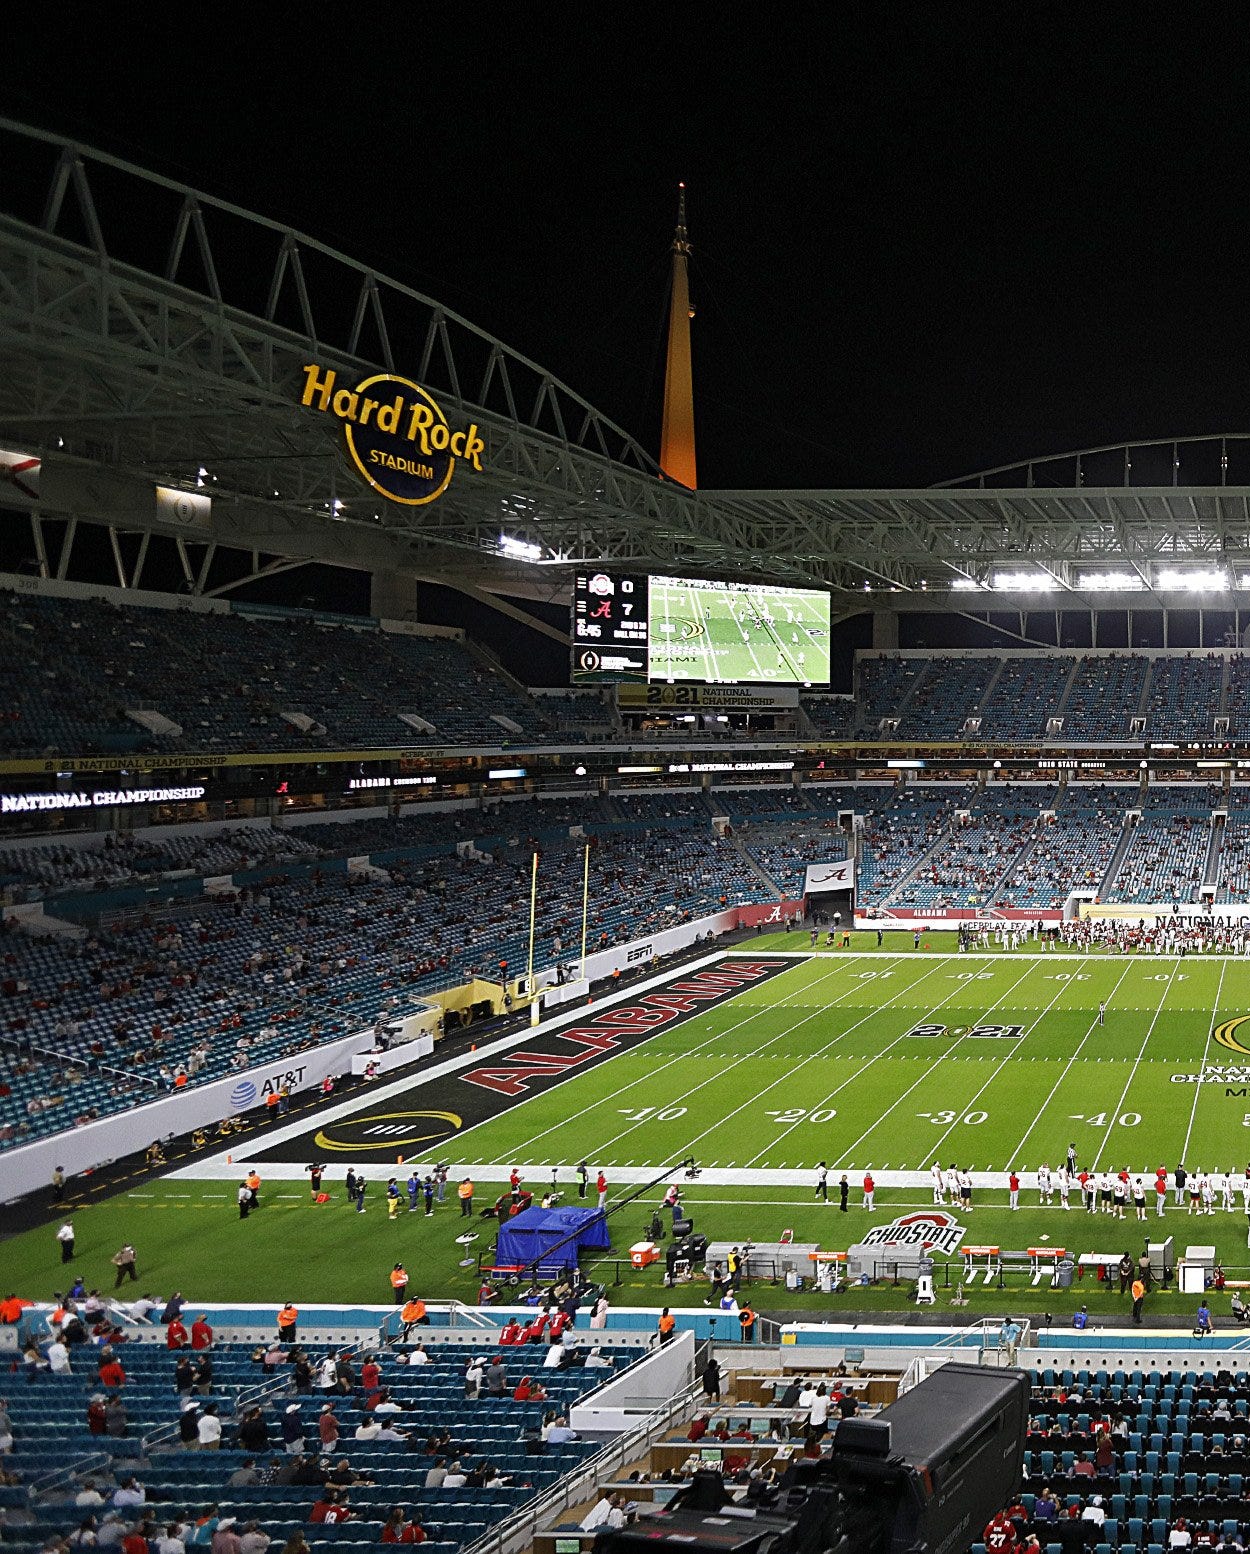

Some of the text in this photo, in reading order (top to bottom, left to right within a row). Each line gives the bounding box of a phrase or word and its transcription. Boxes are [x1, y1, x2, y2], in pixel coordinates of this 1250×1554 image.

[302, 364, 485, 472] Hard Rock
[370, 449, 434, 480] STADIUM
[622, 581, 634, 593] 0
[622, 604, 634, 616] 7
[702, 687, 752, 696] NATIONAL
[702, 697, 775, 706] CHAMPIONSHIP
[79, 759, 143, 770] NATIONAL
[144, 756, 228, 769] CHAMPIONSHIP
[349, 777, 391, 789] ALABAMA
[1, 787, 205, 812] NATIONAL CHAMPIONSHIP
[913, 909, 948, 918] ALABAMA
[1155, 916, 1239, 929] NATIONAL
[627, 944, 654, 963] ESPN
[458, 959, 789, 1097] ALABAMA
[260, 1065, 307, 1097] AT&T
[624, 1107, 688, 1122] 10
[773, 1108, 838, 1123] 20
[930, 1110, 989, 1125] 30
[1086, 1112, 1142, 1127] 40
[907, 1222, 963, 1253] STATE
[989, 1533, 1007, 1548] 27
